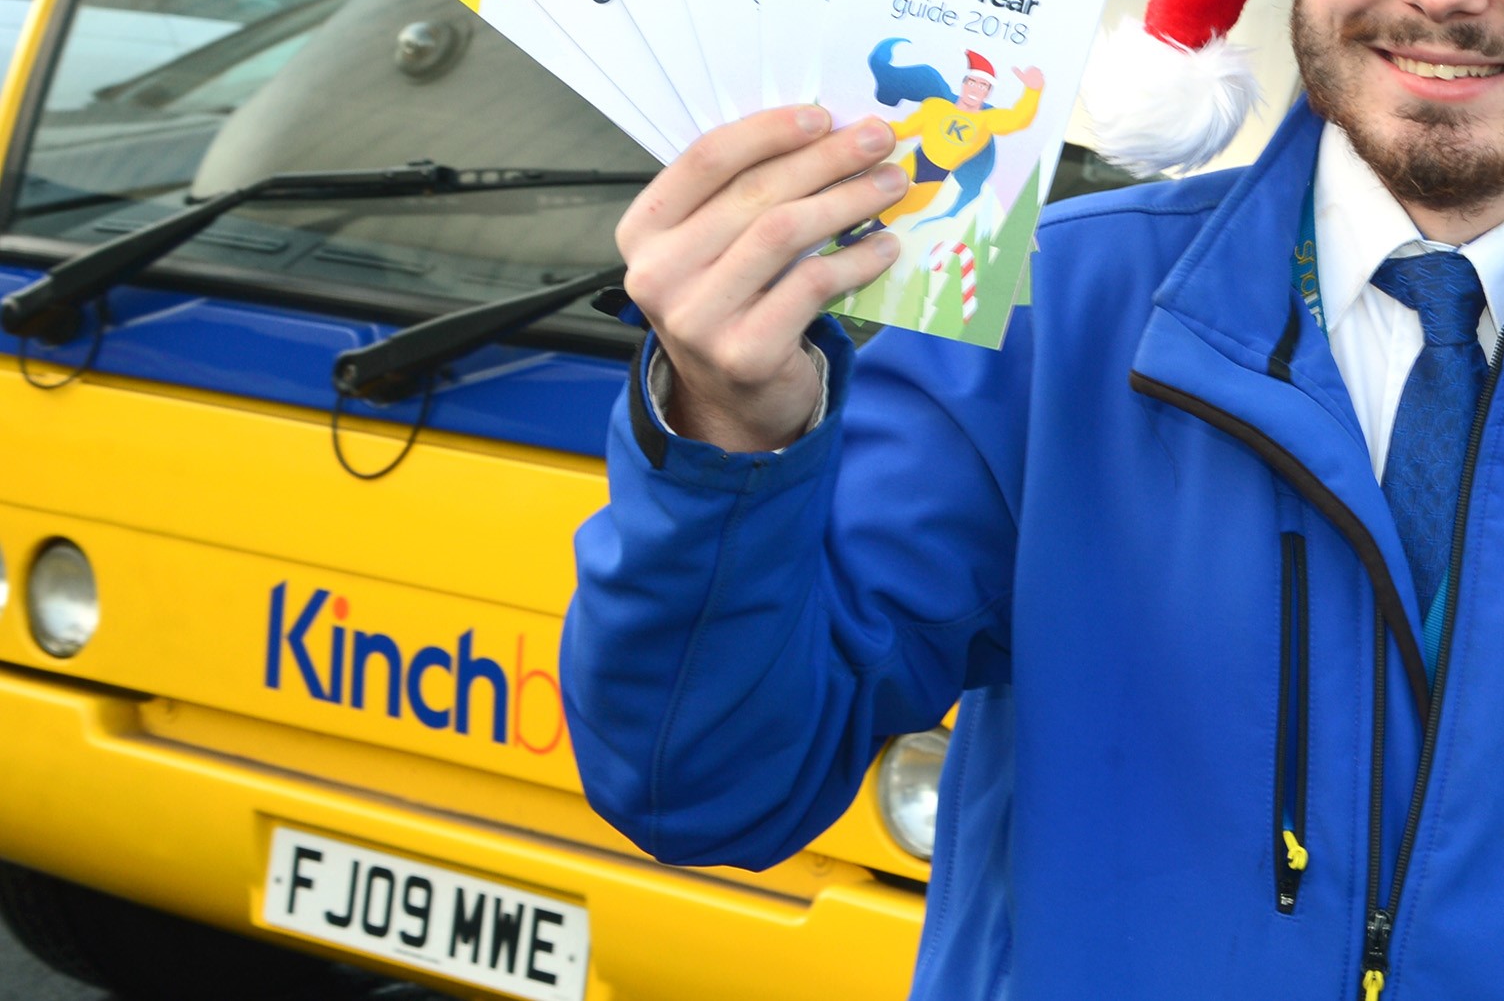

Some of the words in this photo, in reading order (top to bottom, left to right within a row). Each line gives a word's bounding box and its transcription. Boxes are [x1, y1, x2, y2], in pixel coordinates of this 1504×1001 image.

[963, 9, 1030, 46] 2018
[946, 119, 970, 142] K
[264, 580, 567, 756] Kinchb
[286, 845, 434, 949] FJ09
[447, 886, 565, 987] MWE
